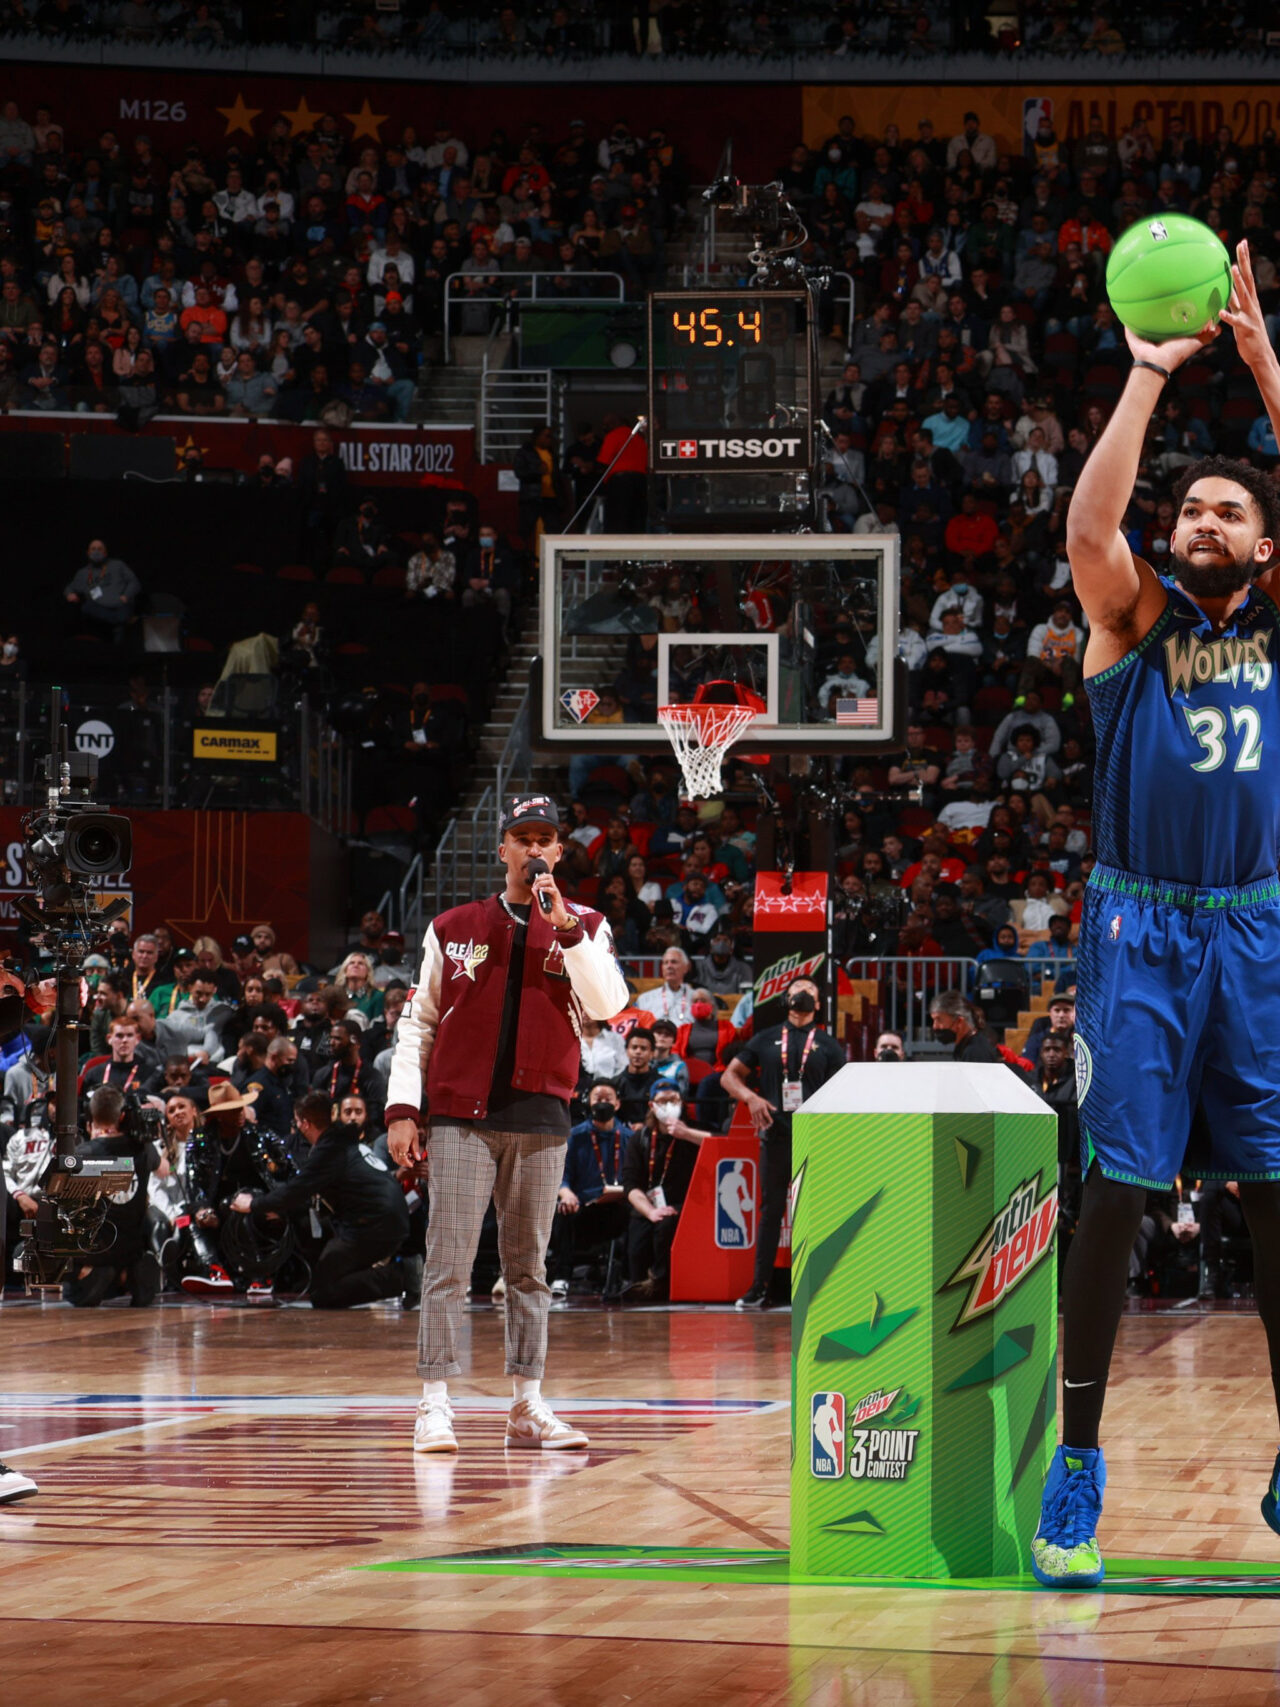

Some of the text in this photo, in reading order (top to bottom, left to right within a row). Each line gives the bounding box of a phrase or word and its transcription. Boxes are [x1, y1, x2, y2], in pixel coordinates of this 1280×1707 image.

[119, 99, 187, 122] M126
[673, 308, 761, 347] 45.4
[368, 442, 412, 472] STAR
[414, 443, 454, 472] 2022
[699, 438, 801, 458] TISSOT
[76, 733, 114, 748] TNT
[1182, 705, 1263, 772] 32
[721, 1228, 740, 1243] NBA
[868, 1430, 919, 1461] POINT
[816, 1459, 832, 1472] NBA
[867, 1461, 908, 1478] CONTEST
